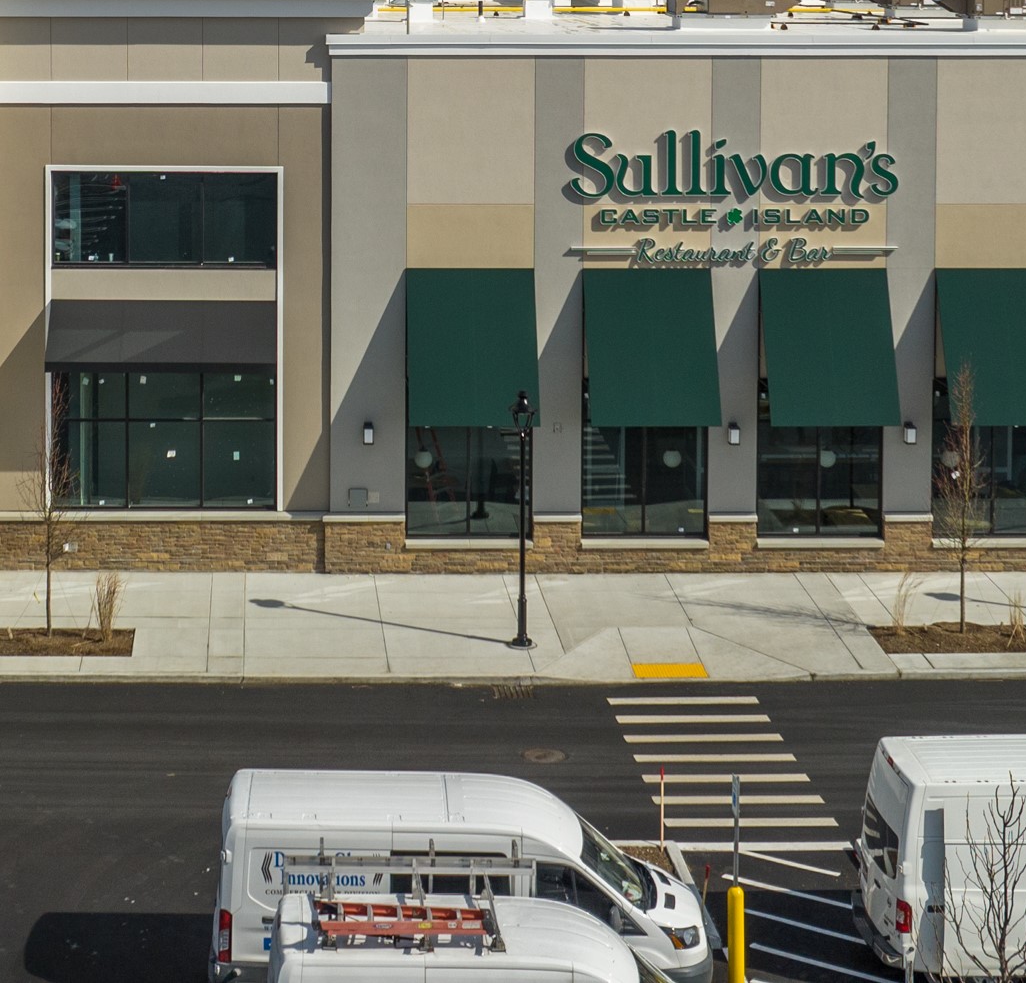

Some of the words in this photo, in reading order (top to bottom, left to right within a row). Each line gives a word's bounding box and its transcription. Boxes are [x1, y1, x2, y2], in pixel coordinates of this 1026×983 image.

[570, 129, 899, 199] Sullivan's
[600, 208, 717, 225] CASTLE
[752, 208, 870, 225] ISLAND
[636, 238, 755, 264] Restaurant
[760, 237, 782, 262] &
[789, 237, 832, 262] Bar
[280, 869, 365, 886] Innovaions
